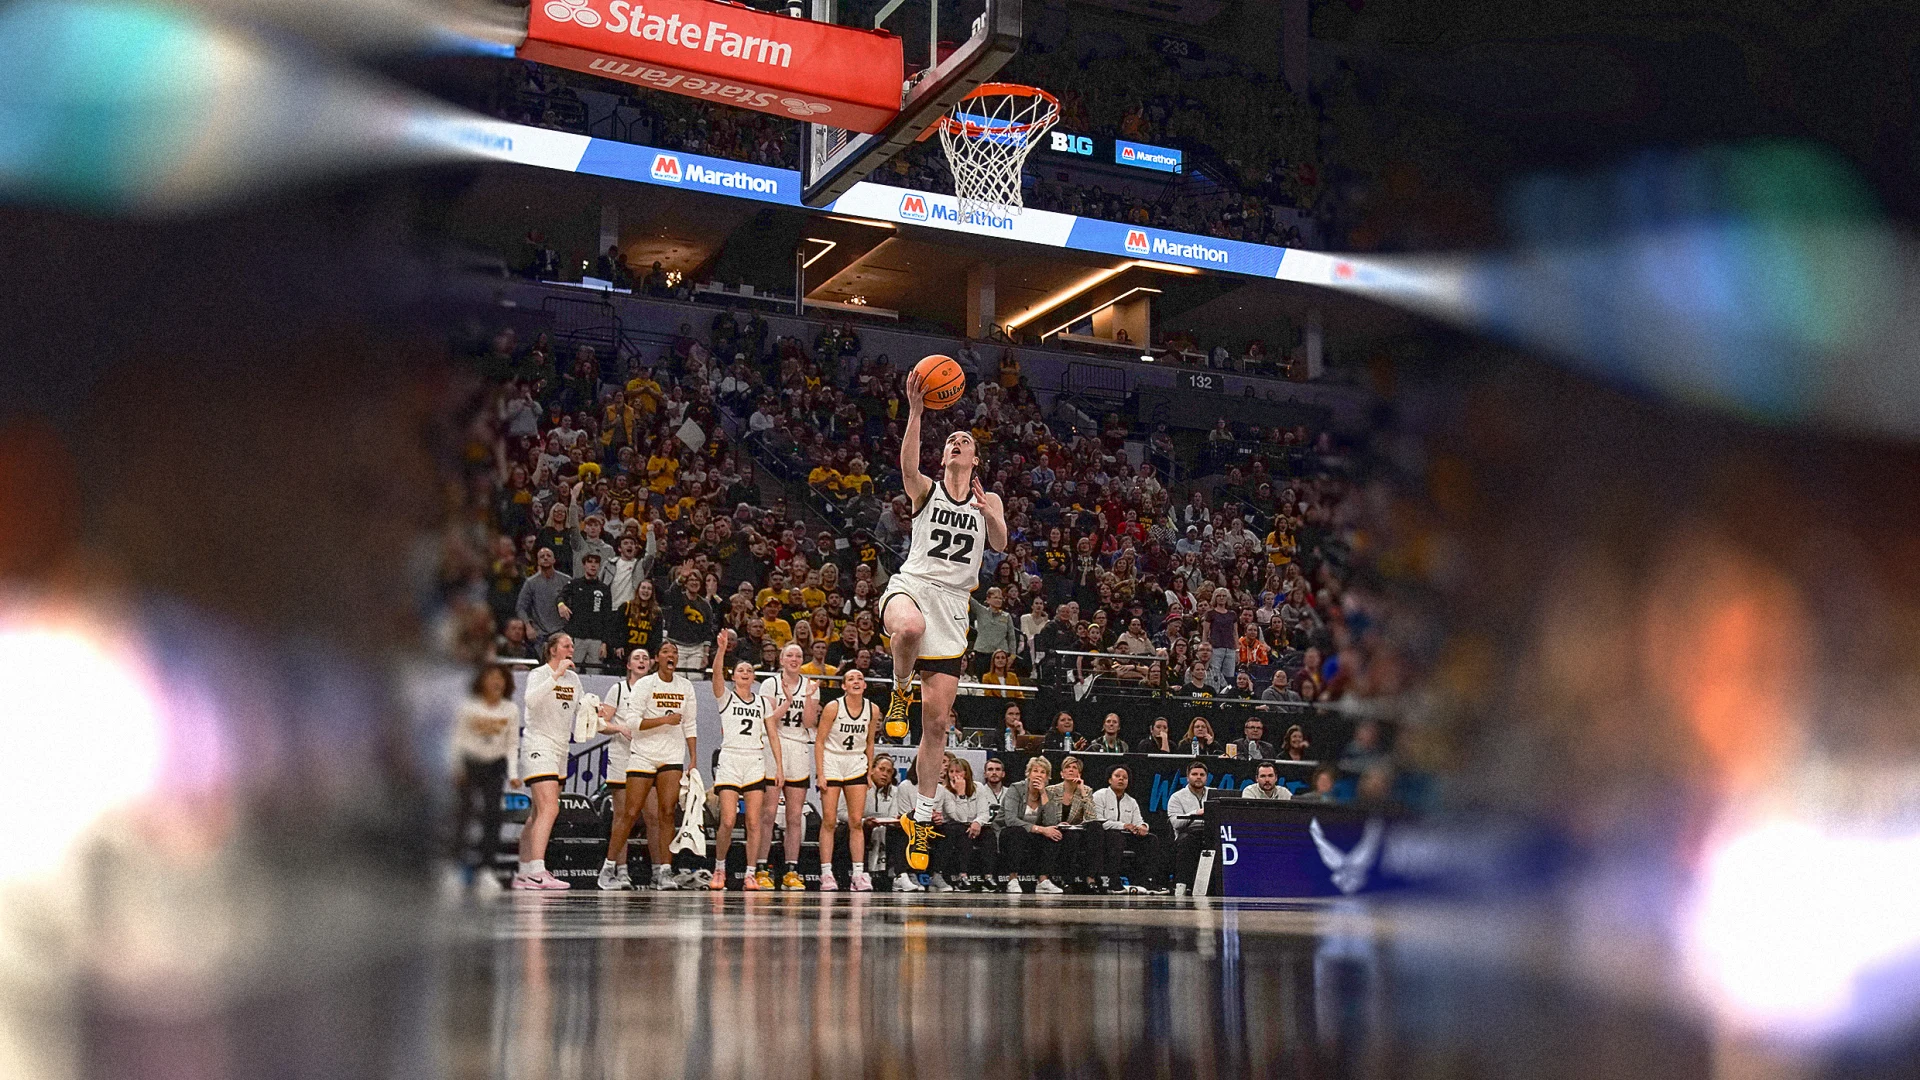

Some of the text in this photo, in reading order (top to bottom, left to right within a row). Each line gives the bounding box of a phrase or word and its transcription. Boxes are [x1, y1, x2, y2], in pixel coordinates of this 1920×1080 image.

[1162, 39, 1188, 55] 233
[1136, 150, 1177, 166] Marathon
[684, 163, 779, 195] Marathon
[931, 203, 1014, 231] Maathon
[1152, 237, 1229, 264] Marathon
[1189, 374, 1213, 389] 132
[937, 380, 965, 400] Wilso
[929, 506, 979, 533] IOWA
[927, 528, 975, 565] 22
[628, 629, 649, 645] 20
[779, 697, 805, 710] IWA
[732, 706, 762, 719] IOWA
[779, 710, 804, 728] 44
[739, 718, 754, 736] 2
[839, 723, 867, 734] IOWA
[842, 735, 855, 751] 4
[562, 799, 591, 810] TIAA
